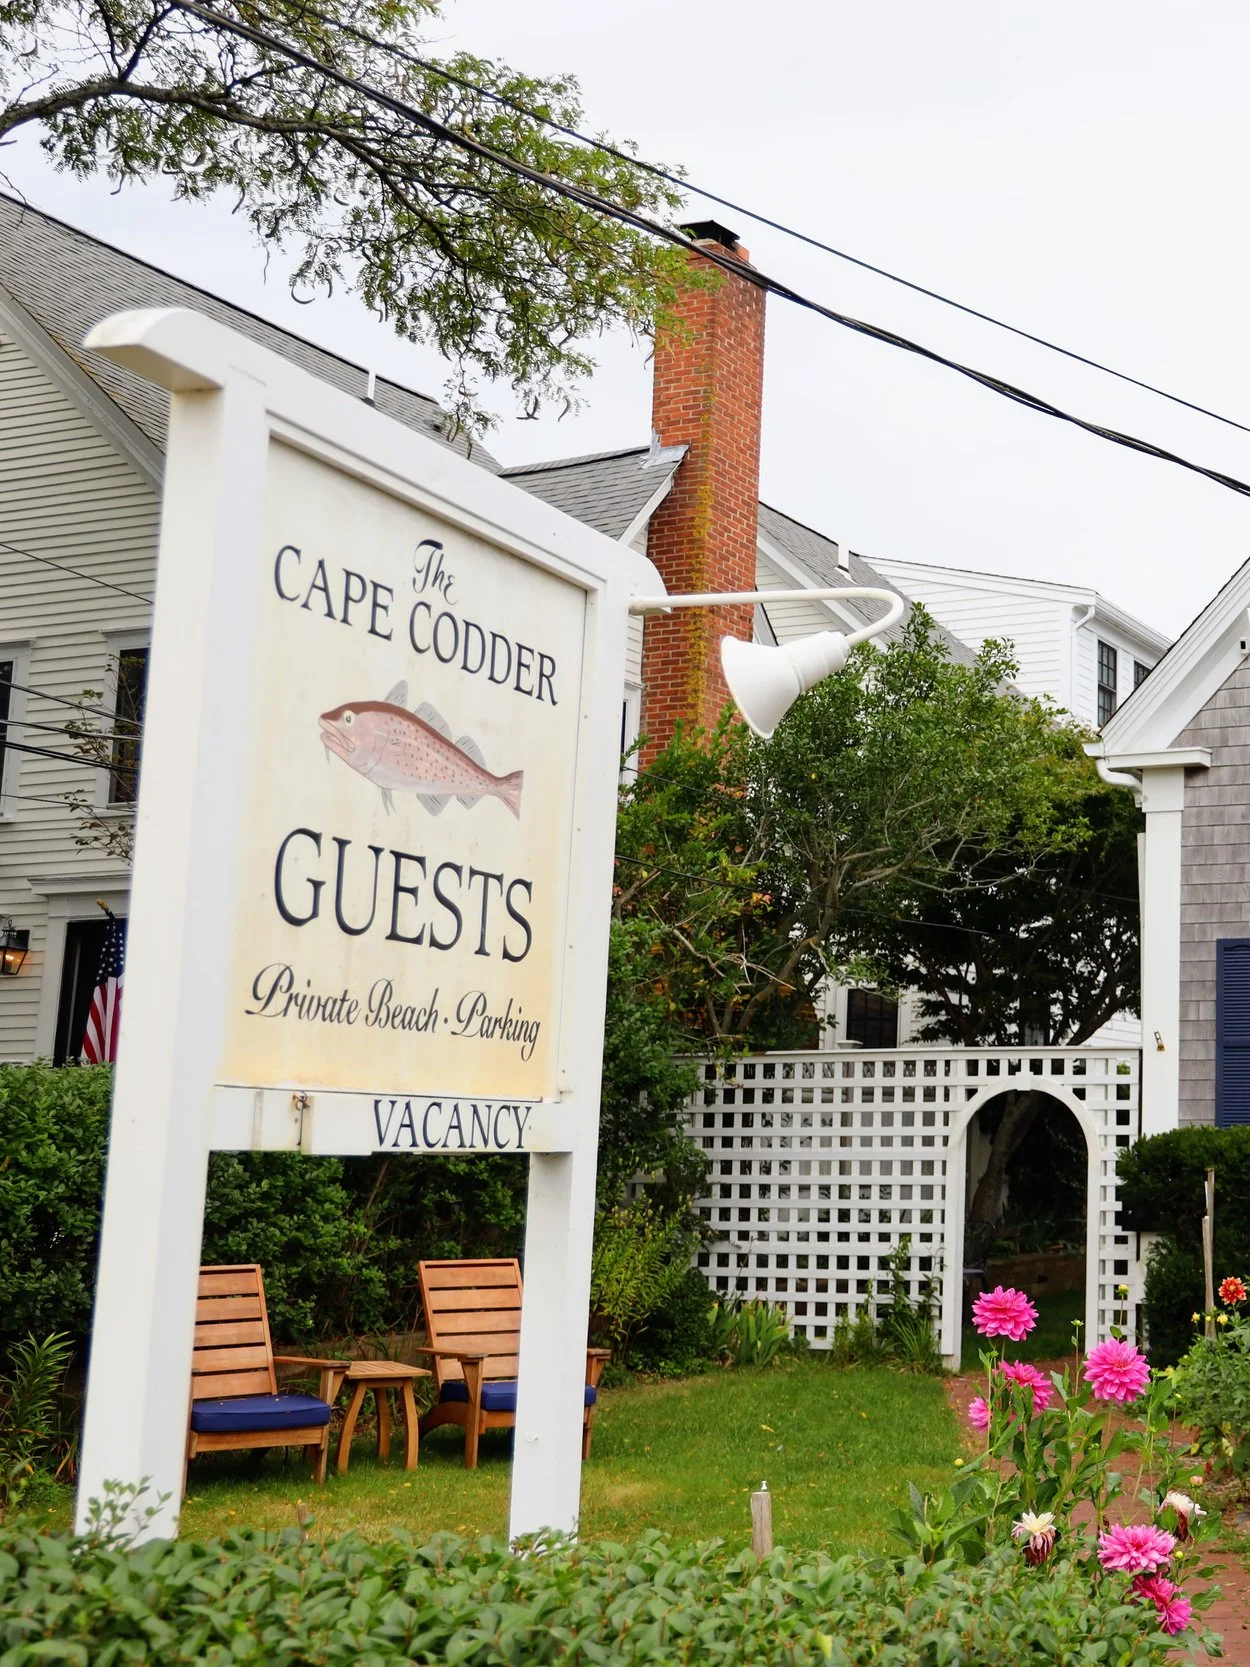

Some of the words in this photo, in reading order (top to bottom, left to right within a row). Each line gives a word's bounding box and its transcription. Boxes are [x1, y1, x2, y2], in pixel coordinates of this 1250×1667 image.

[412, 539, 458, 606] The
[273, 545, 394, 642] CAPE
[408, 600, 559, 707] CODDER
[273, 827, 534, 963] GUESTS
[244, 963, 361, 1026] Private
[364, 978, 440, 1034] Beach
[450, 990, 542, 1062] Parking
[373, 1099, 532, 1150] VACANCY
